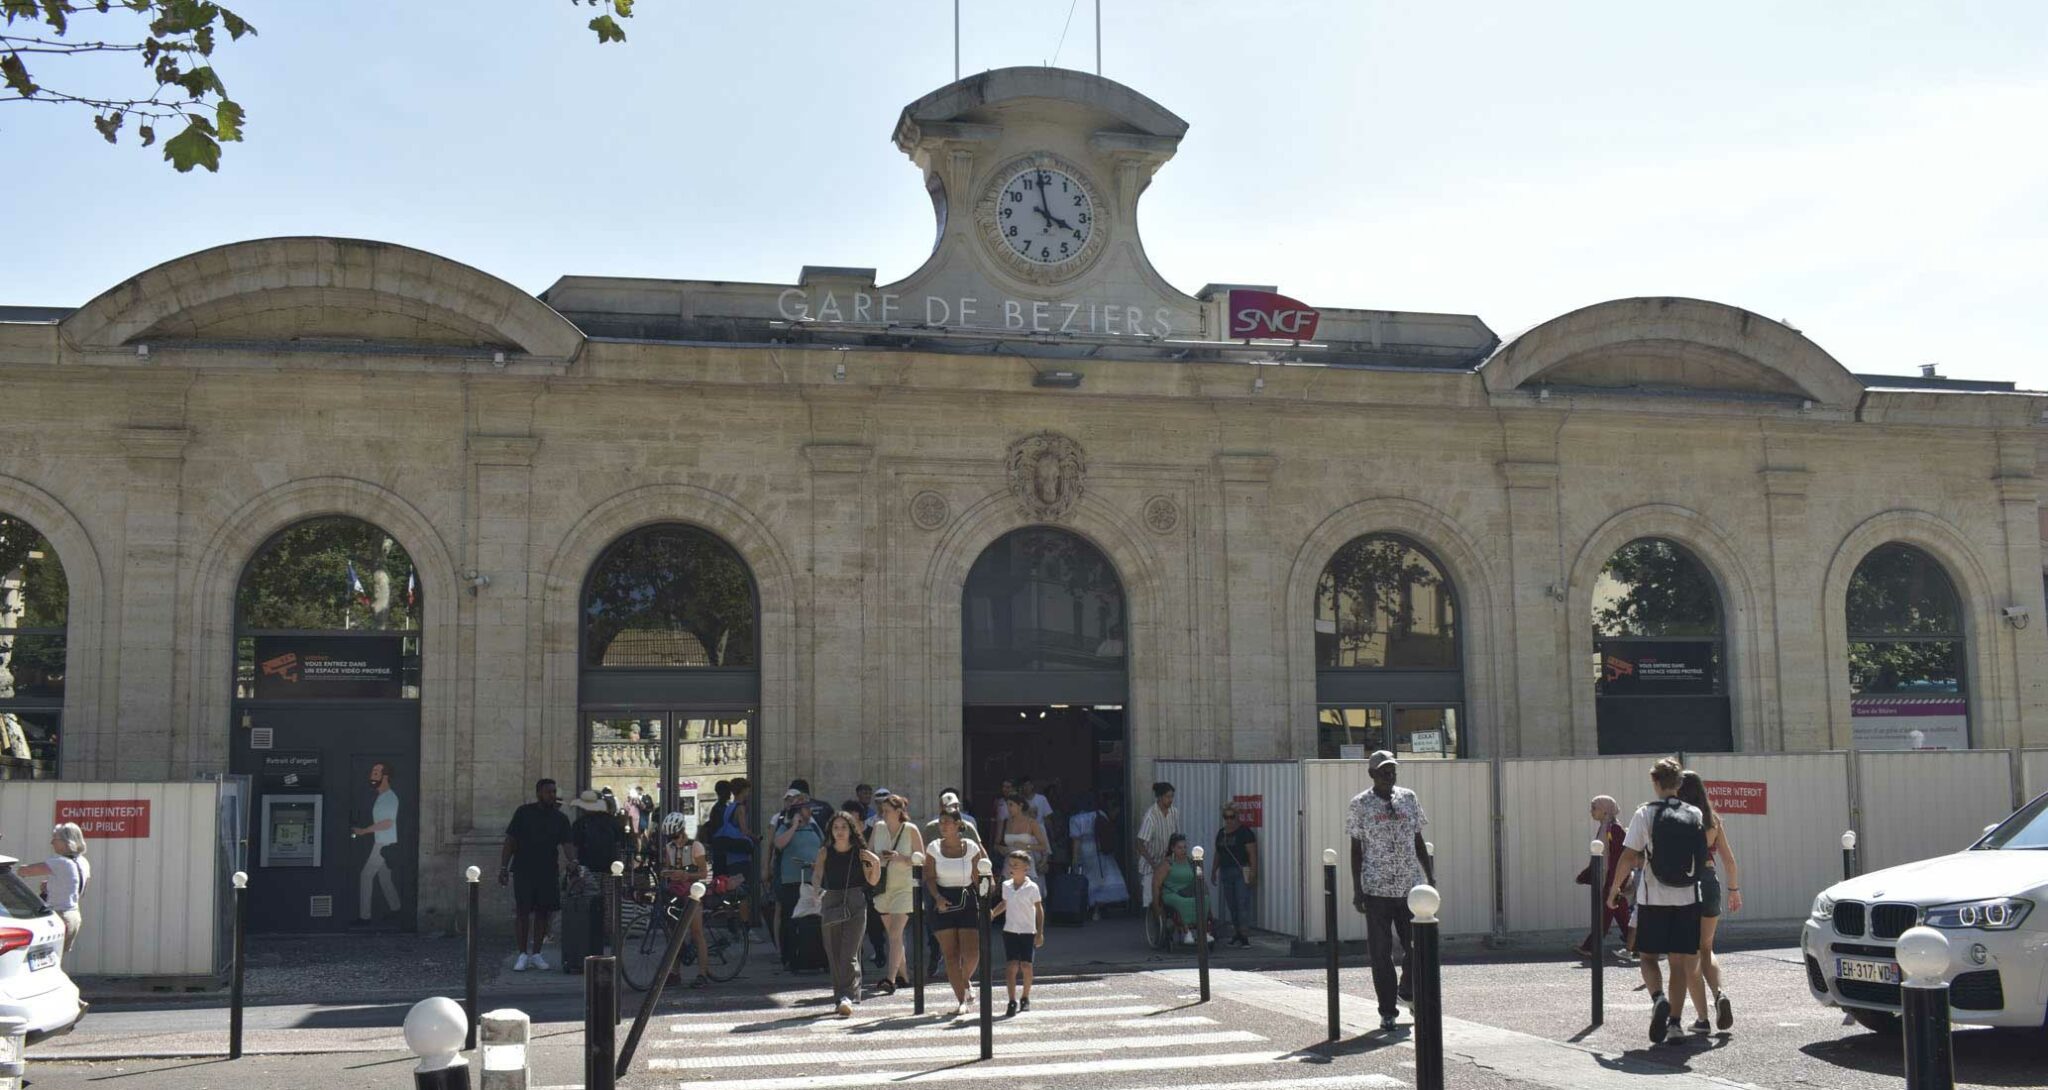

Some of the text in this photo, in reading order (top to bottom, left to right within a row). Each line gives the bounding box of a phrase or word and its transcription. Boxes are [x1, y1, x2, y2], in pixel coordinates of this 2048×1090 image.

[1023, 179, 1032, 190] 11
[1062, 182, 1067, 192] 1
[1010, 191, 1022, 202] 10
[1073, 195, 1081, 206] 2
[1004, 208, 1012, 218] 9
[1078, 213, 1086, 224] 3
[1009, 225, 1018, 237] 8
[1073, 229, 1081, 240] 4
[1023, 240, 1032, 251] 7
[1060, 242, 1068, 253] 5
[1041, 247, 1050, 258] 6
[778, 288, 900, 325] GARE
[926, 295, 977, 328] DE
[1233, 308, 1316, 334] SNCF
